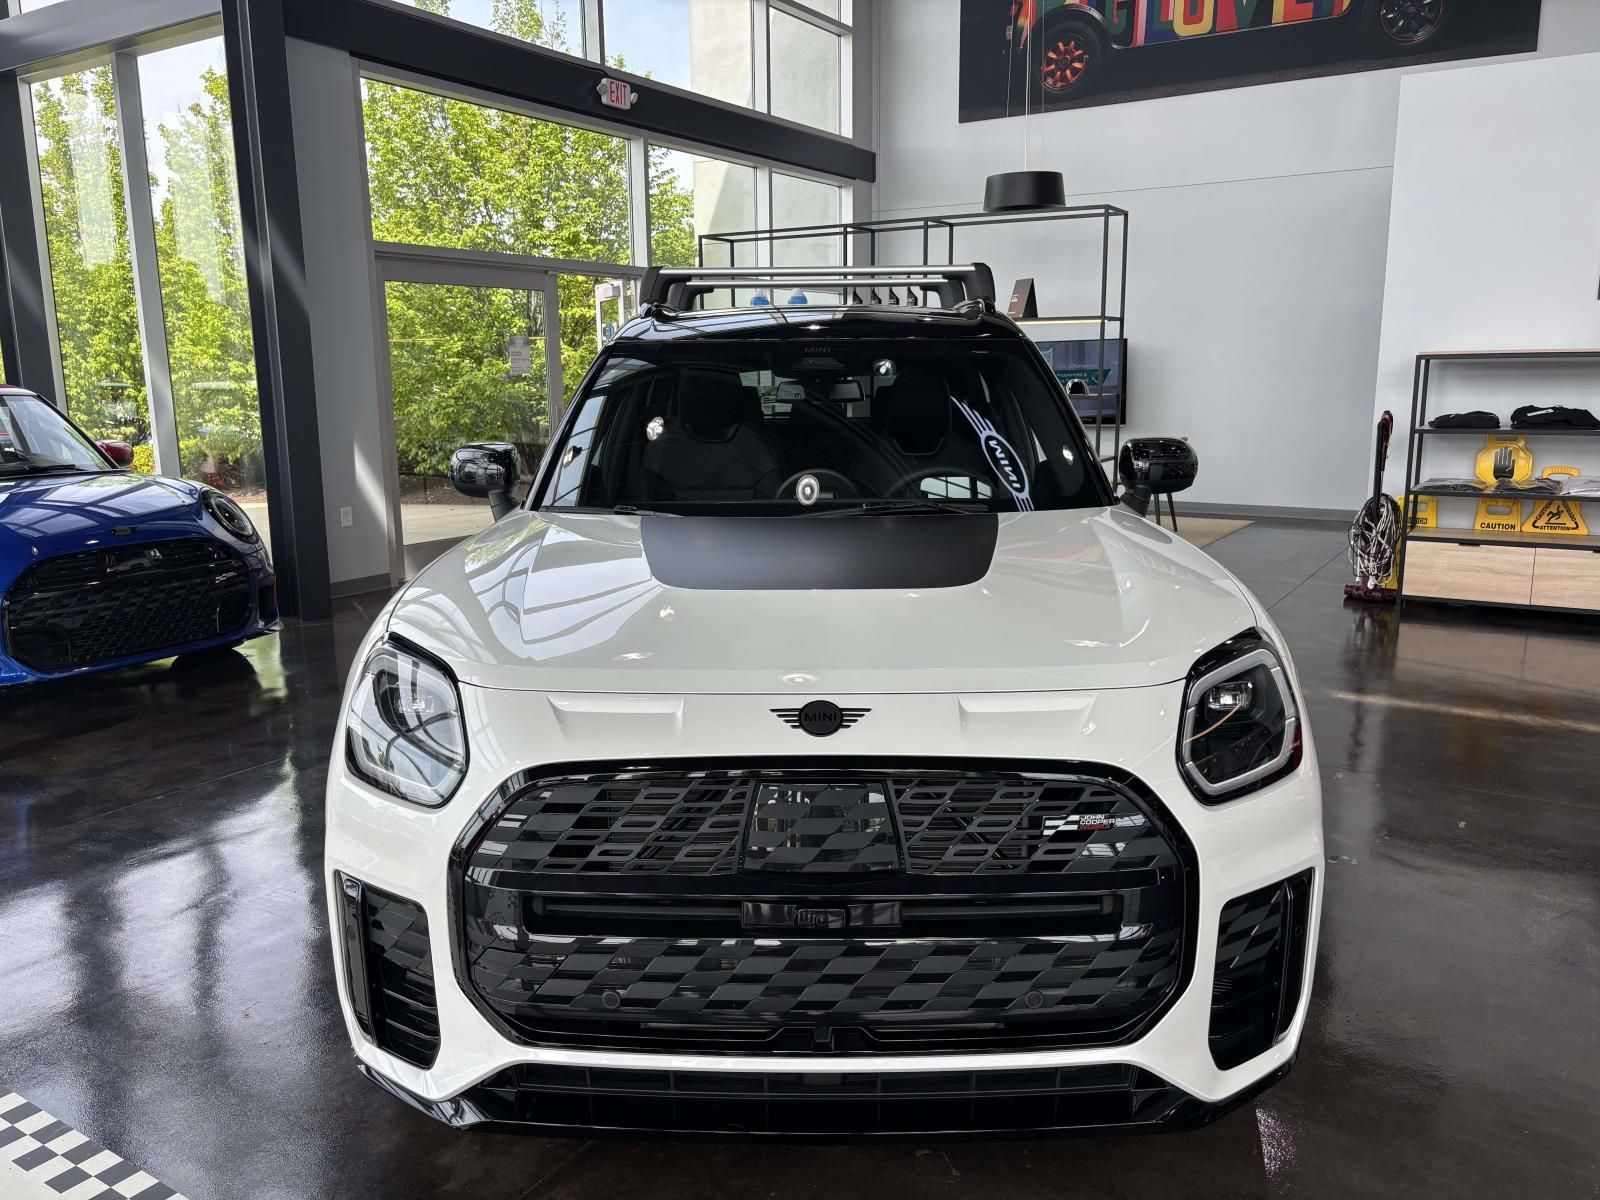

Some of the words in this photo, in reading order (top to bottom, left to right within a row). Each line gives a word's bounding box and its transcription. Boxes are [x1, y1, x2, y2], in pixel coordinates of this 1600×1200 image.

[610, 80, 628, 106] EXIT
[1480, 522, 1516, 530] CAUTION
[804, 712, 837, 722] MINI
